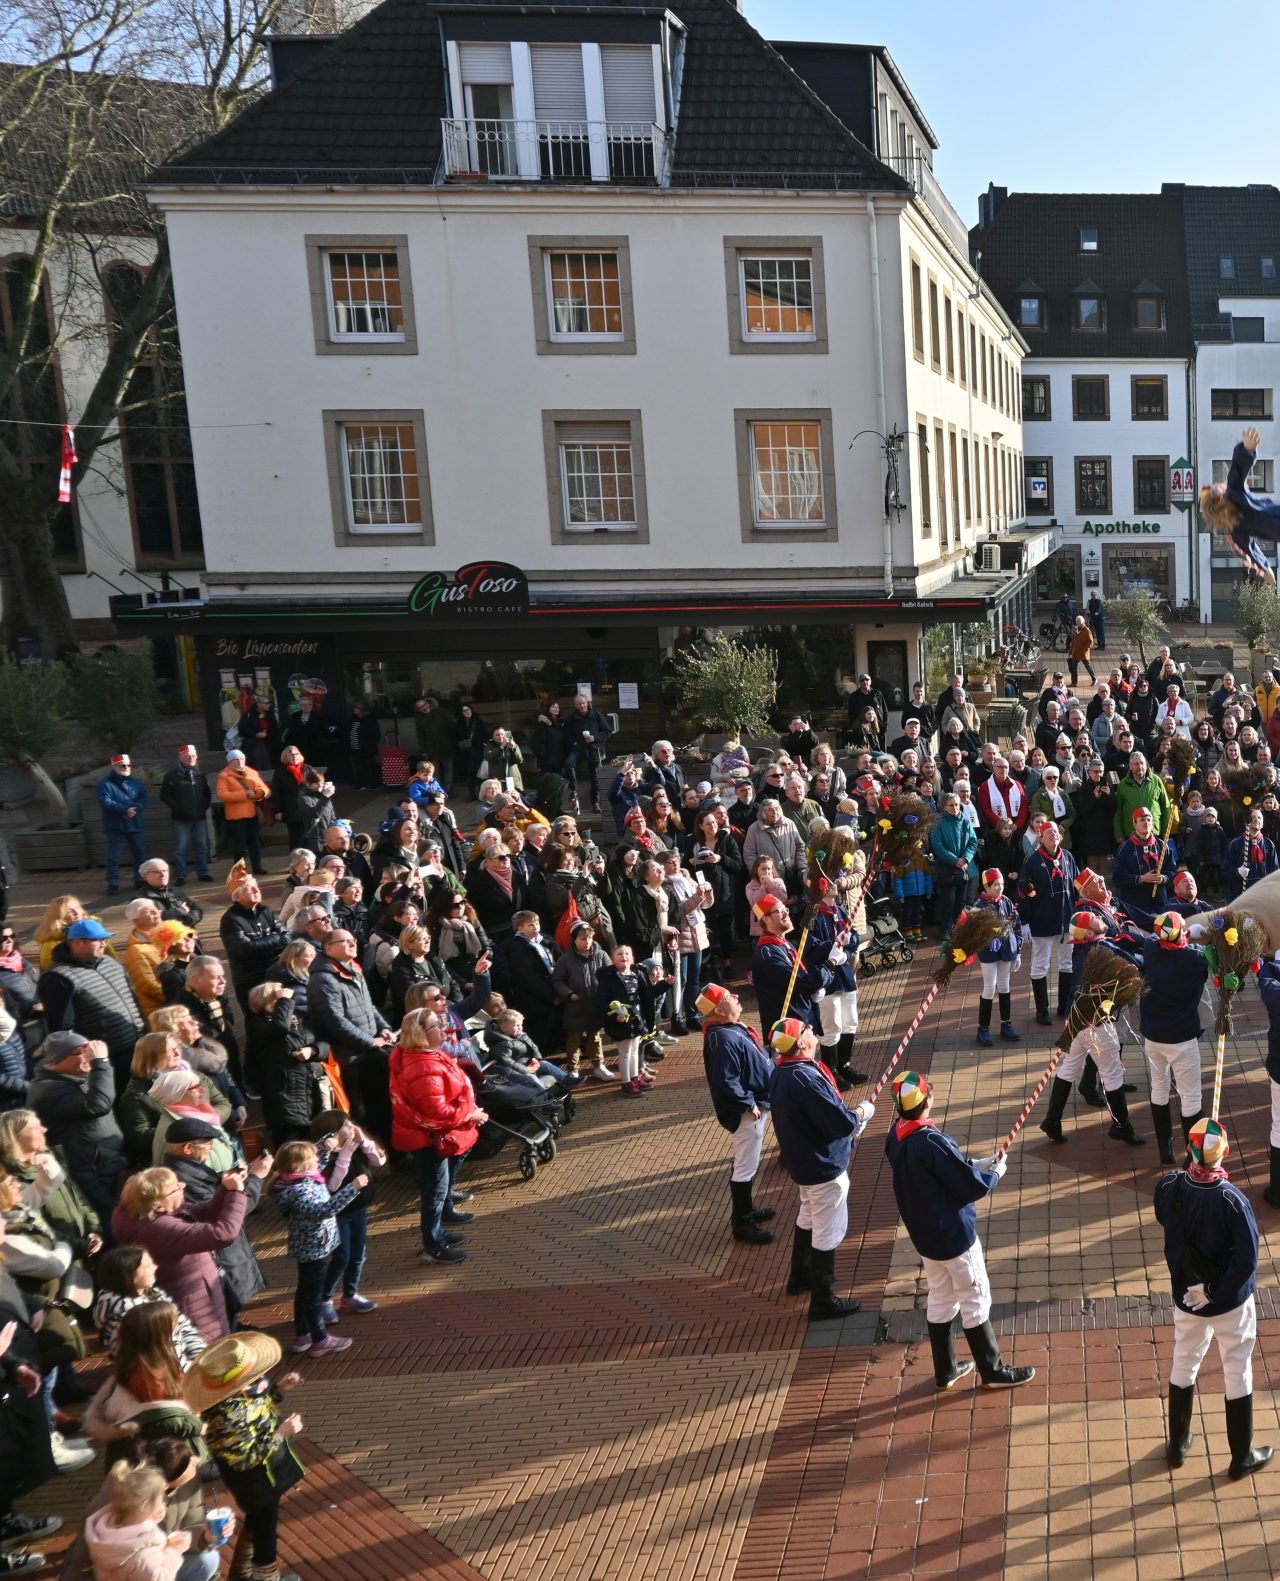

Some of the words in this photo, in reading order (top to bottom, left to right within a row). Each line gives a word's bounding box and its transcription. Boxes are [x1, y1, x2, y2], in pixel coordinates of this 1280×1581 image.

[1083, 520, 1161, 537] Apotheke
[216, 638, 239, 656] Bio
[242, 638, 319, 660] Limonaden
